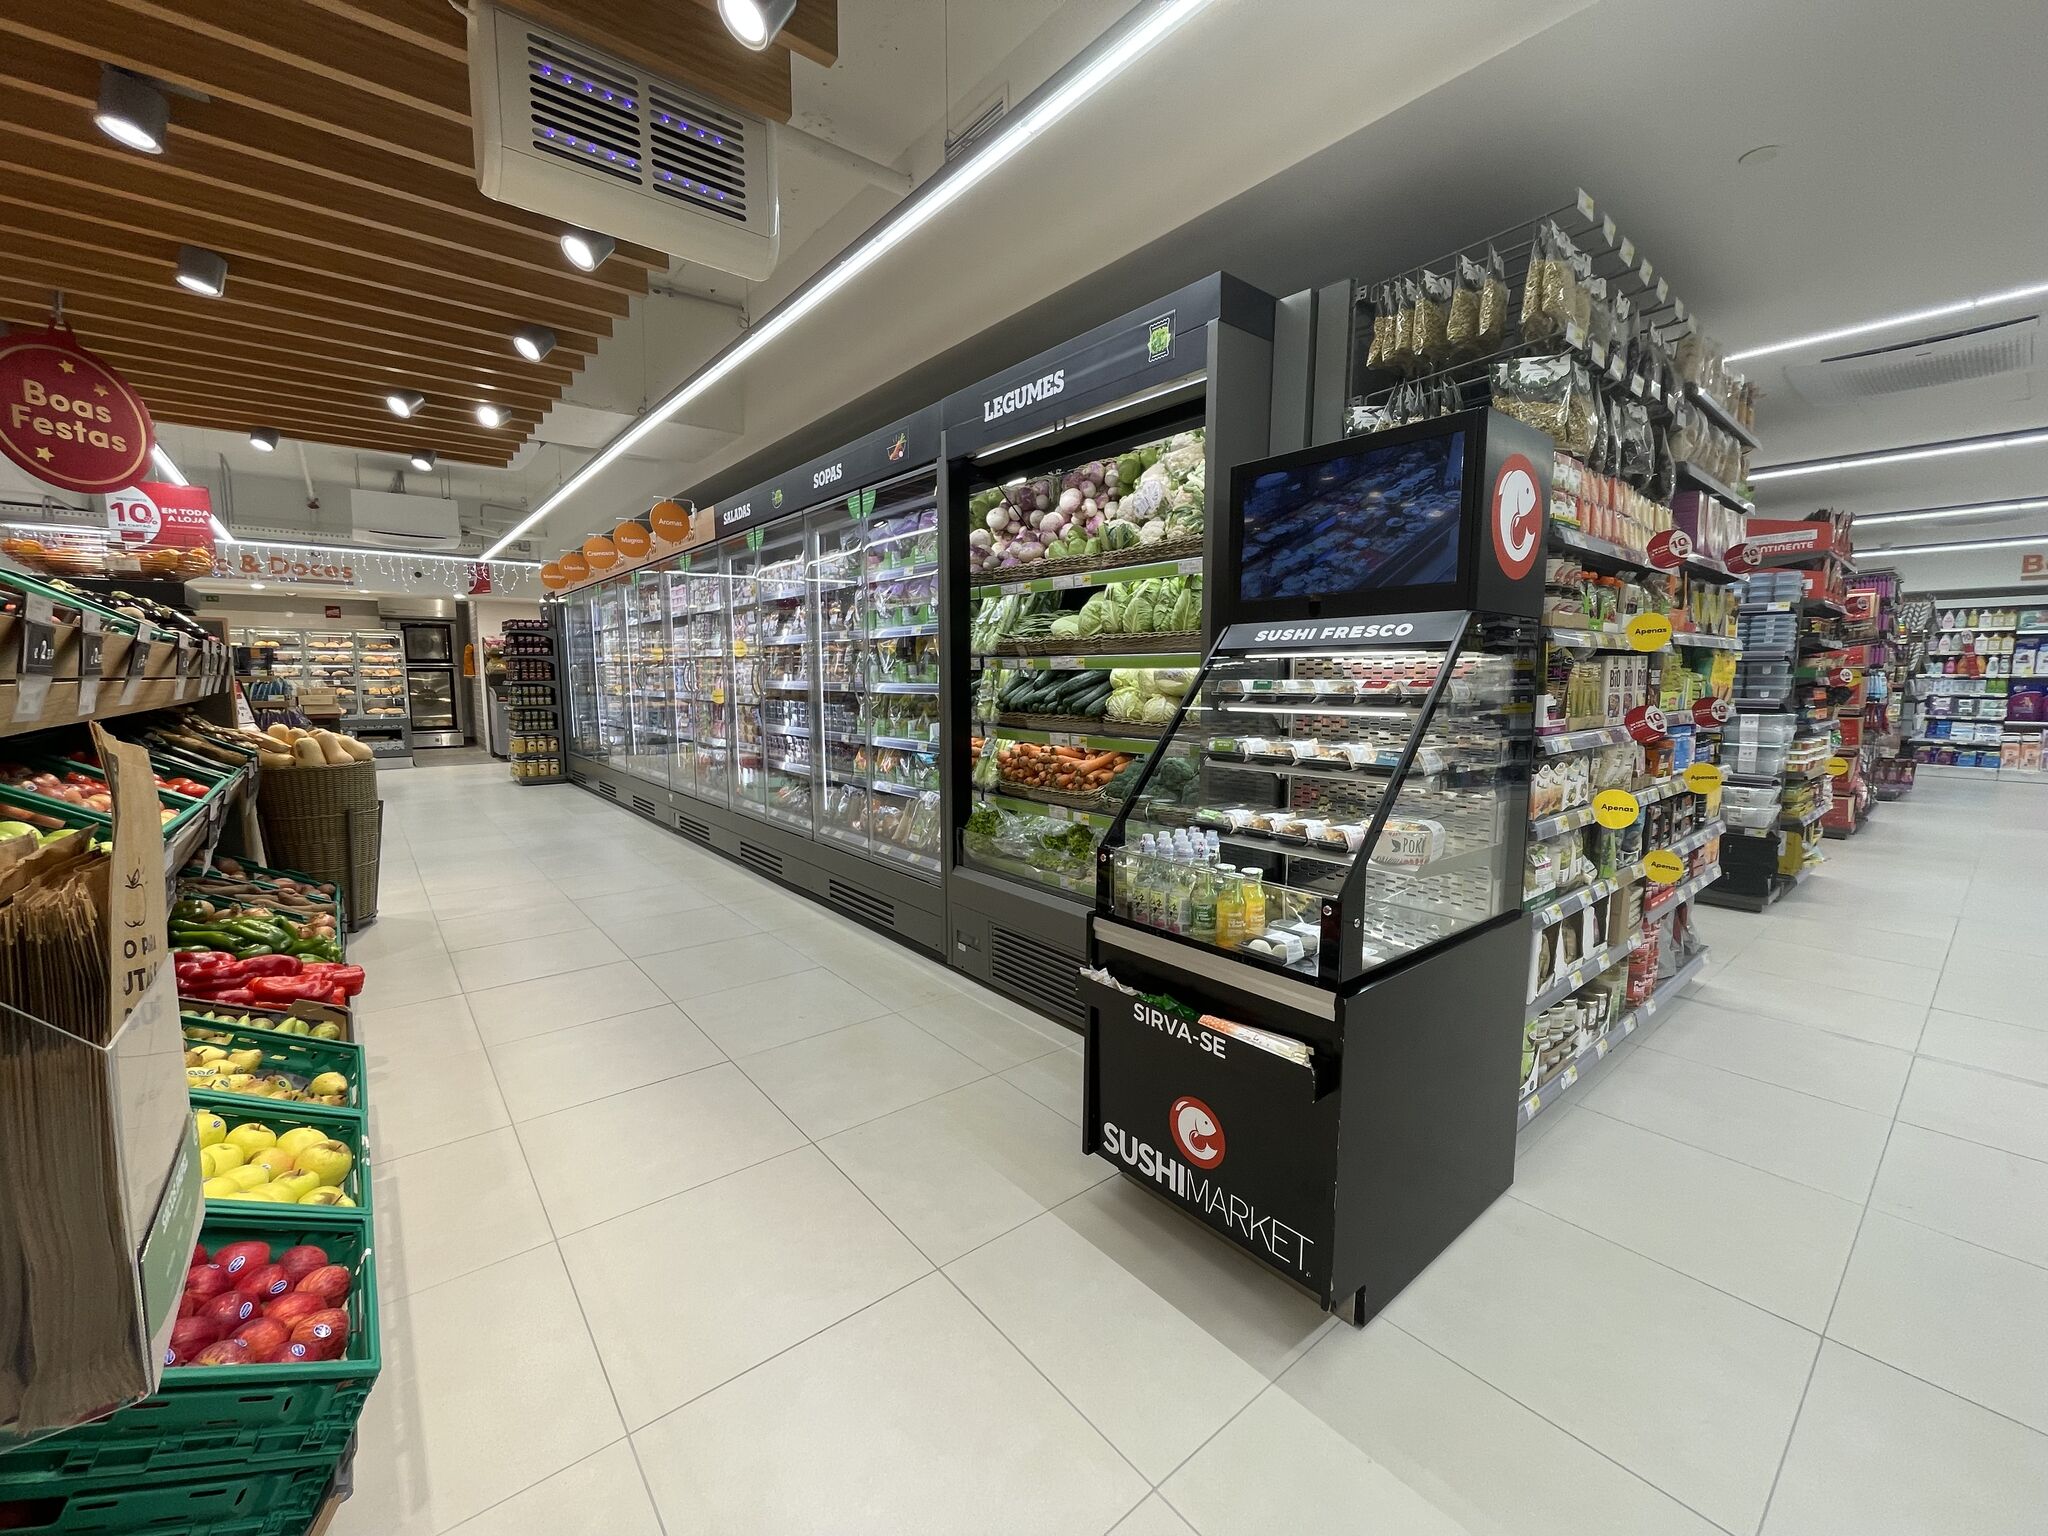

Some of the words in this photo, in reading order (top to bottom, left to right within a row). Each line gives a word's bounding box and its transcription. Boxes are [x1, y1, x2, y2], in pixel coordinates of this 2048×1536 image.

[23, 379, 112, 423] Boas
[984, 369, 1065, 423] LEGUMES
[11, 403, 128, 452] Festas
[813, 463, 842, 489] SOPAS
[161, 507, 177, 515] EM
[179, 508, 210, 517] TODA
[178, 516, 206, 524] LOJA
[723, 503, 751, 525] SALADAS
[658, 518, 683, 527] Aromas
[1671, 537, 1687, 549] 10
[1760, 541, 1814, 553] NTINENTE
[269, 556, 352, 579] Doces
[2022, 554, 2048, 574] B
[1254, 627, 1318, 642] SUSHI
[1319, 623, 1414, 640] FRESCO
[1635, 626, 1667, 635] Apenas
[1646, 712, 1662, 724] 10
[1601, 803, 1634, 813] Apenas
[1650, 861, 1680, 872] Apenas
[1132, 1003, 1227, 1060] SIRVA-SE
[1103, 1121, 1315, 1273] SUSHIMARKET
